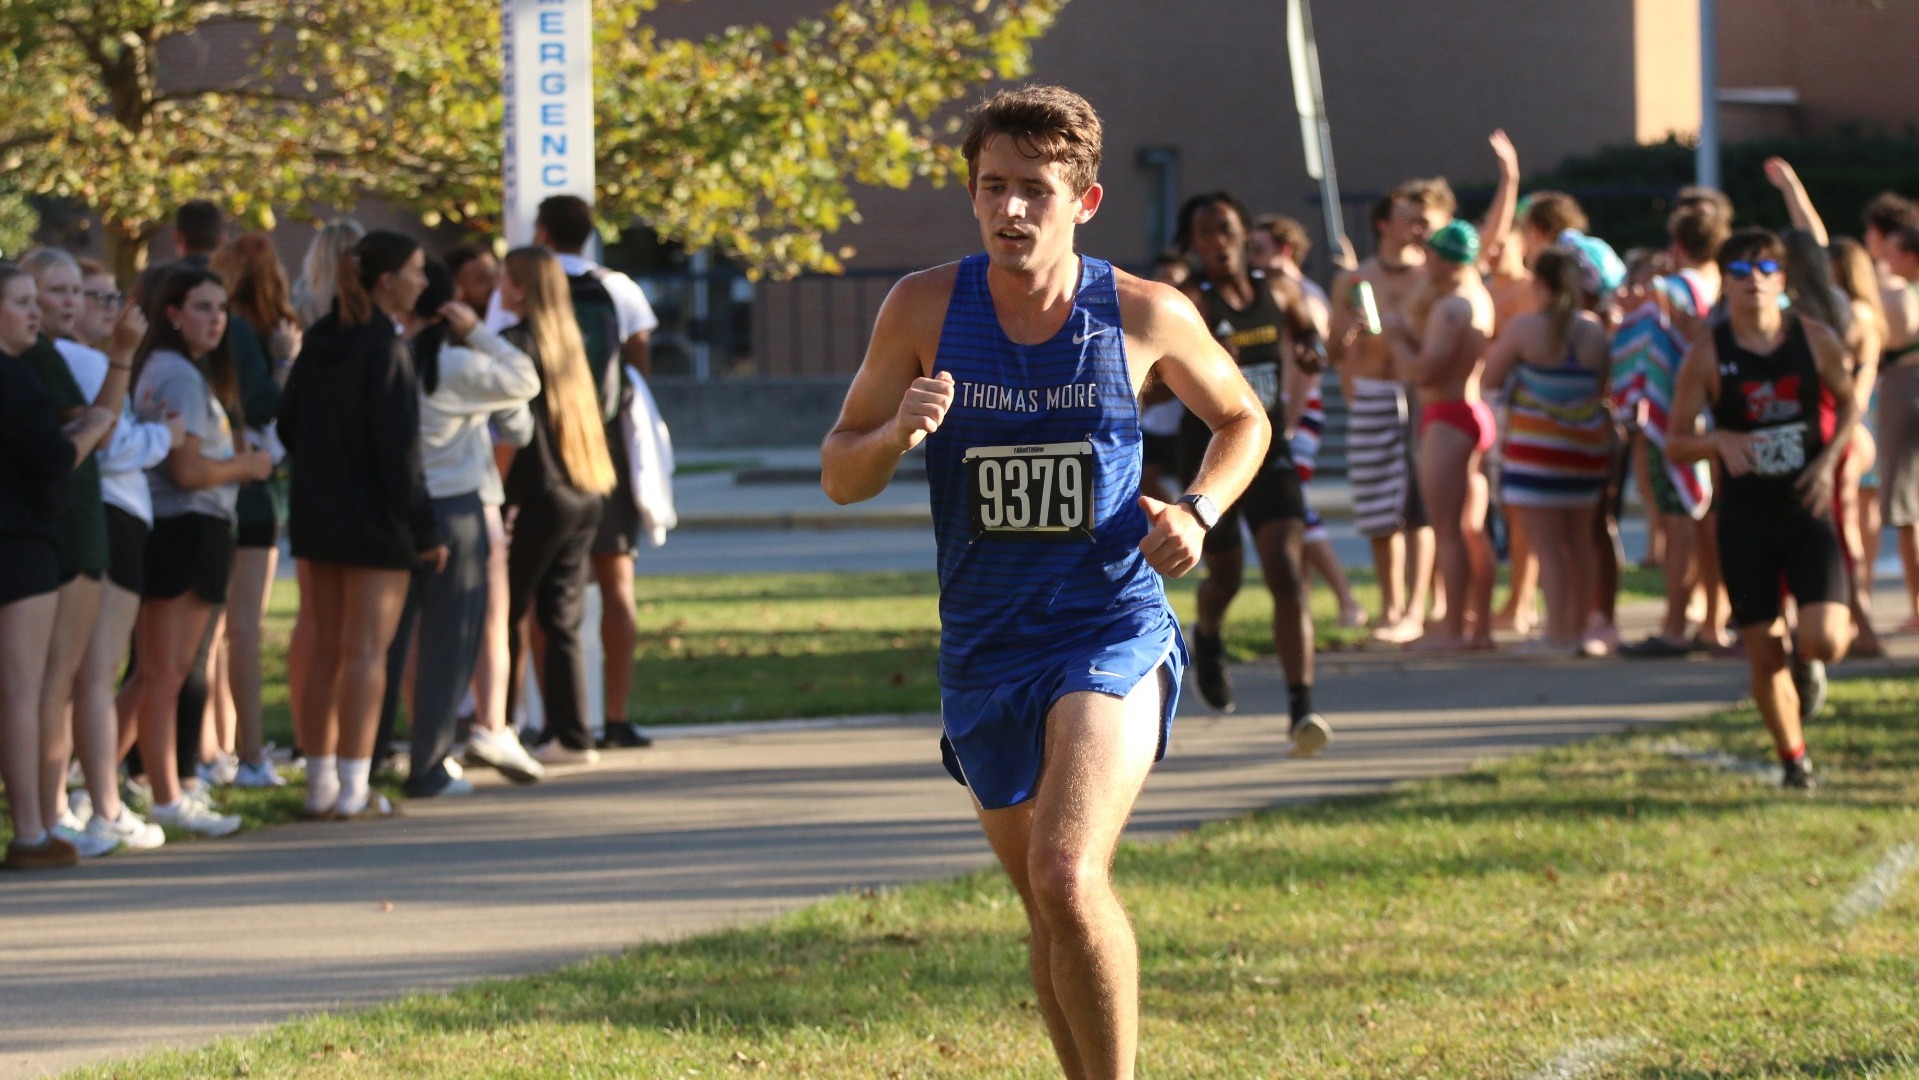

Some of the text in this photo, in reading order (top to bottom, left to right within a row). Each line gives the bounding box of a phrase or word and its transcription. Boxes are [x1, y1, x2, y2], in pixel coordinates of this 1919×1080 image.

[538, 0, 568, 200] ERGENC
[962, 382, 1097, 413] THOMAS MORE
[978, 457, 1083, 528] 9379
